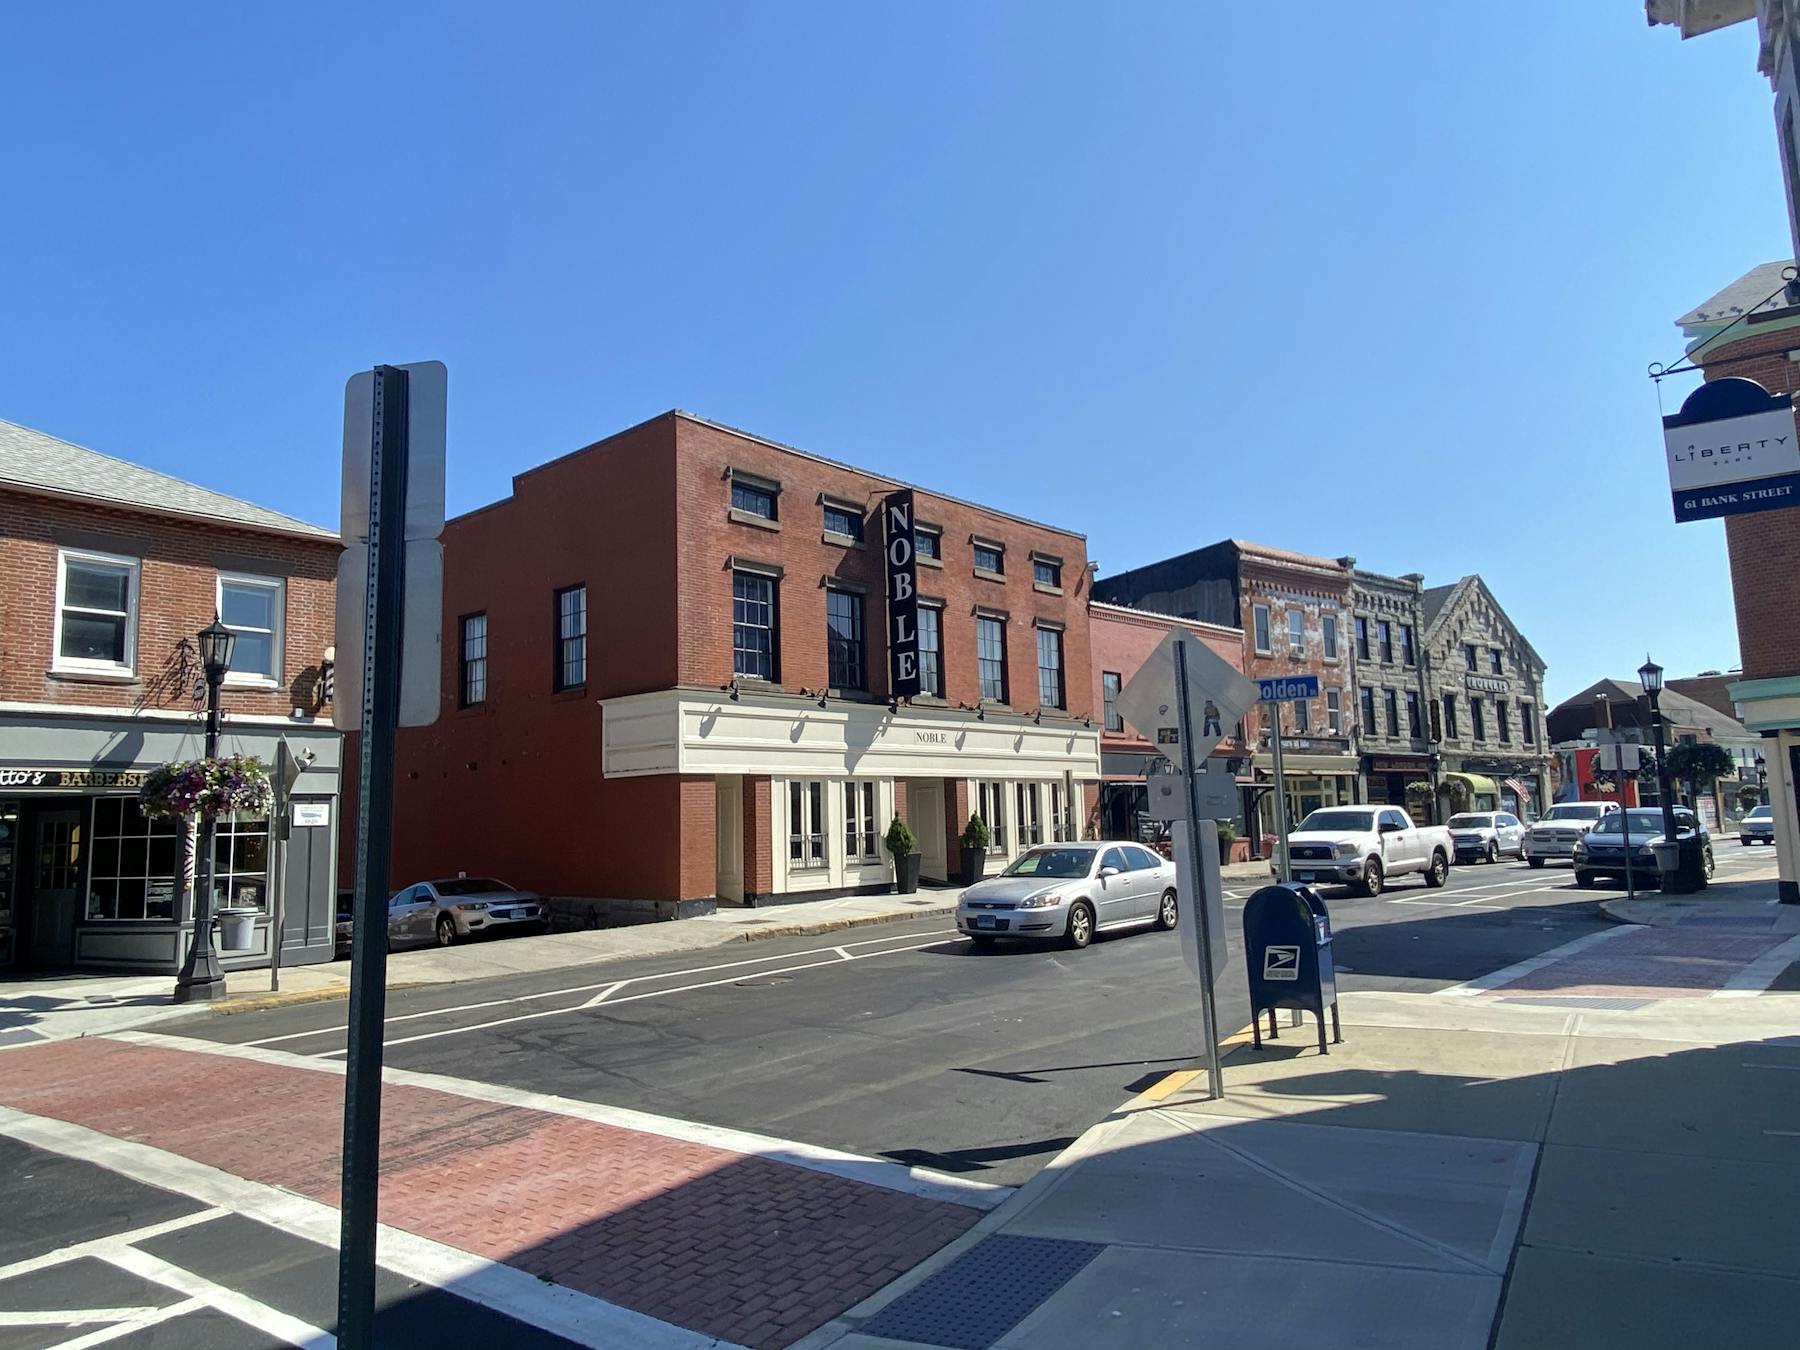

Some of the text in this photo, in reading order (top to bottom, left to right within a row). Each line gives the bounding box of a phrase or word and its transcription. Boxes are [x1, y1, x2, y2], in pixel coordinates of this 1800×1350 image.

[1675, 436, 1788, 462] LIBERTY
[1684, 486, 1793, 510] 61 BANK STREET
[890, 503, 917, 681] NOBLE
[916, 731, 947, 744] NOBLE
